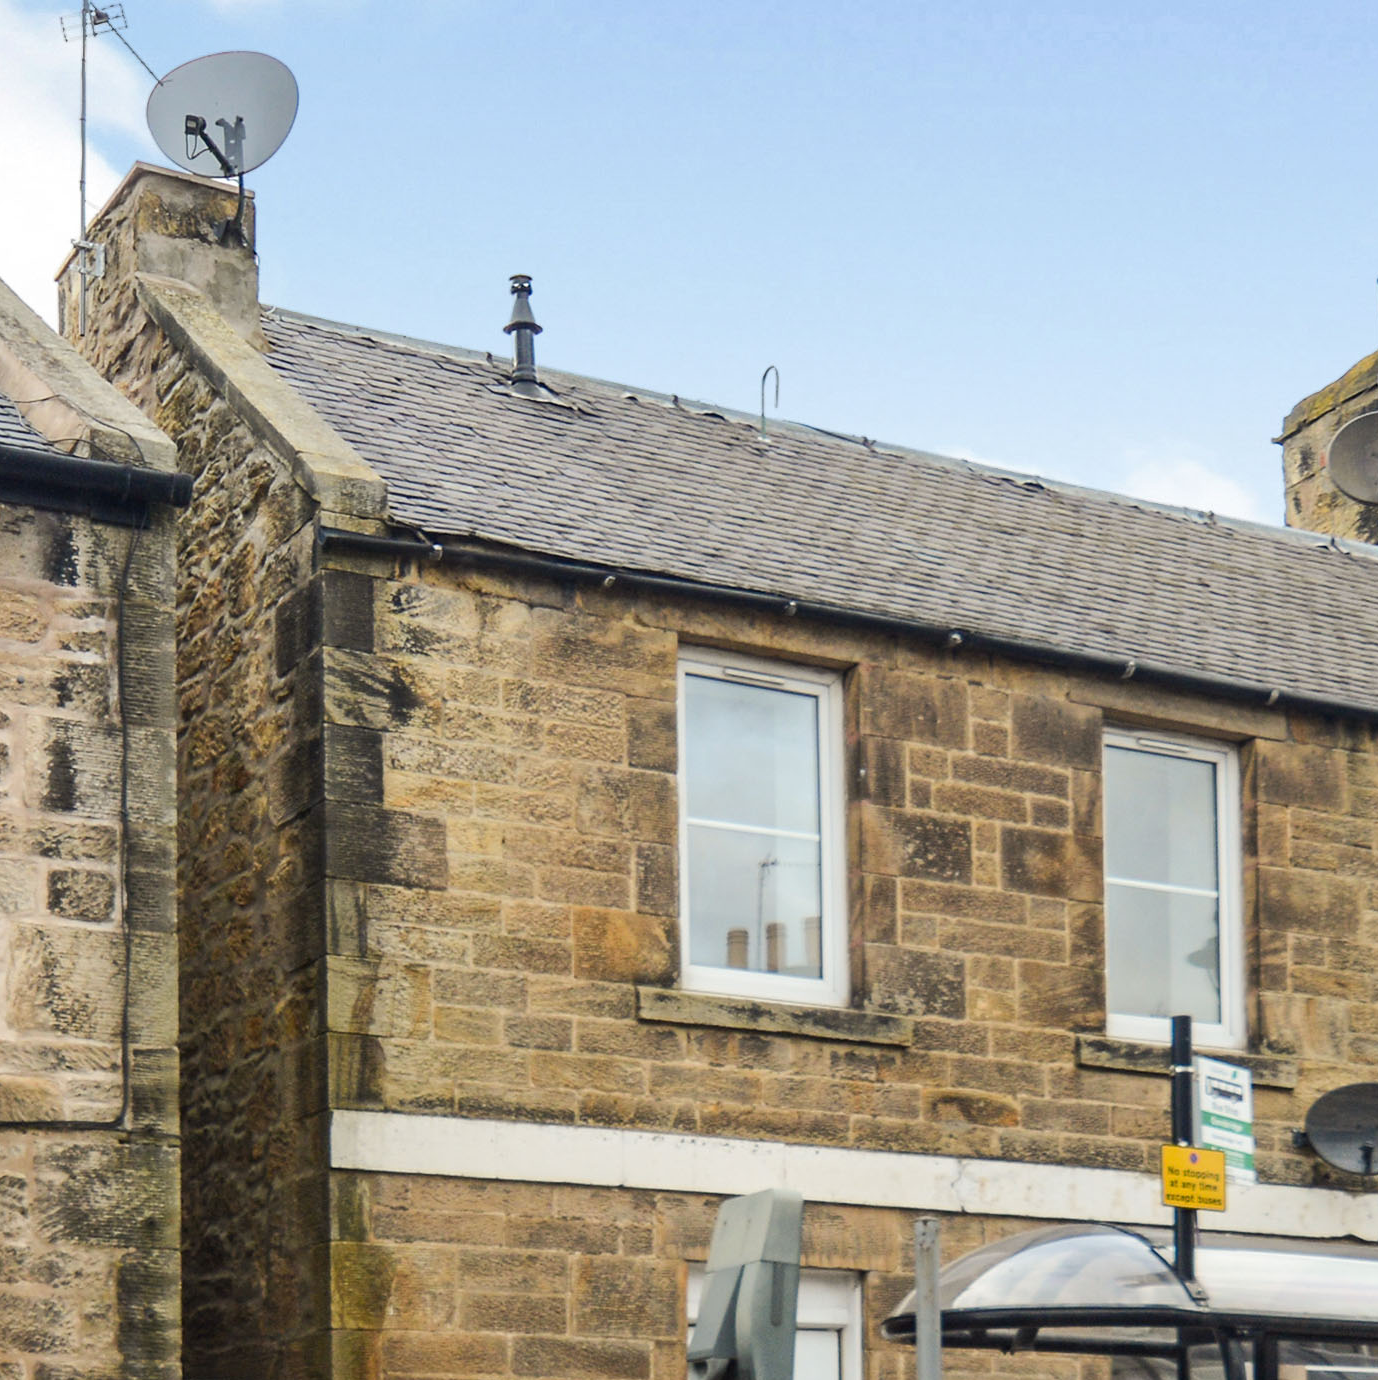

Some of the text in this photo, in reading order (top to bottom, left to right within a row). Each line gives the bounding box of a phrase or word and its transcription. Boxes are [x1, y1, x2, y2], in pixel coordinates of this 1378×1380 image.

[1167, 1166, 1220, 1182] No stopping
[1170, 1179, 1218, 1191] at any time
[1166, 1193, 1222, 1205] except buses
